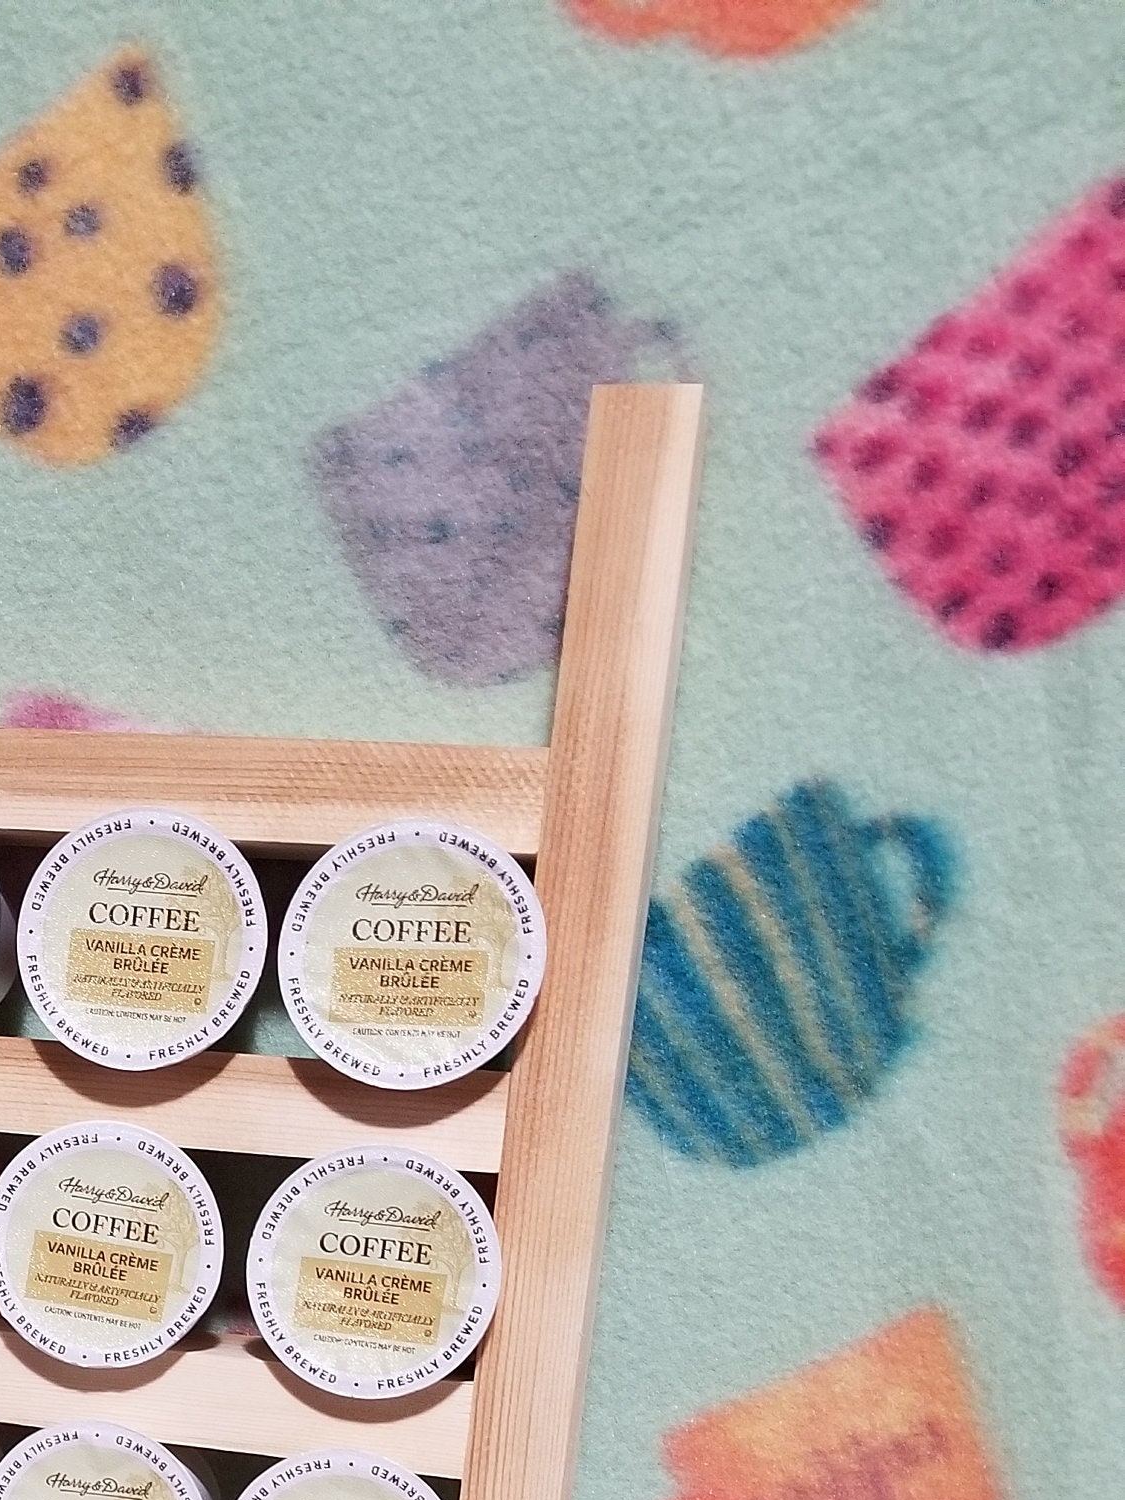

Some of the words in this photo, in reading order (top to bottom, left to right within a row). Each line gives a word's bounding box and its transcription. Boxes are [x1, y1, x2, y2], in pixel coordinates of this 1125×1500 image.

[88, 902, 200, 933] COFFEE
[351, 919, 471, 944] COFFEE
[85, 938, 147, 956] VANILLA
[349, 957, 416, 971] VANILLA
[149, 1027, 209, 1061] FRESHLY
[211, 970, 250, 1028] BREWED
[288, 977, 323, 1038] FRESHLY
[323, 1040, 381, 1076] BREWED
[423, 1039, 487, 1077] FRESHLY
[489, 979, 529, 1039] BREWED
[52, 1207, 159, 1245] COFFEE
[47, 1240, 106, 1263] VANILLA
[109, 1251, 159, 1272] CRÈME
[319, 1232, 433, 1266] COFFEE
[73, 1261, 128, 1282] BRÛLÉE
[315, 1266, 378, 1287] VANILLA
[105, 1335, 164, 1363] FRESHLY
[167, 1285, 207, 1338] BREWED
[377, 1359, 439, 1390] FRESHLY
[442, 1306, 483, 1360] BREWED
